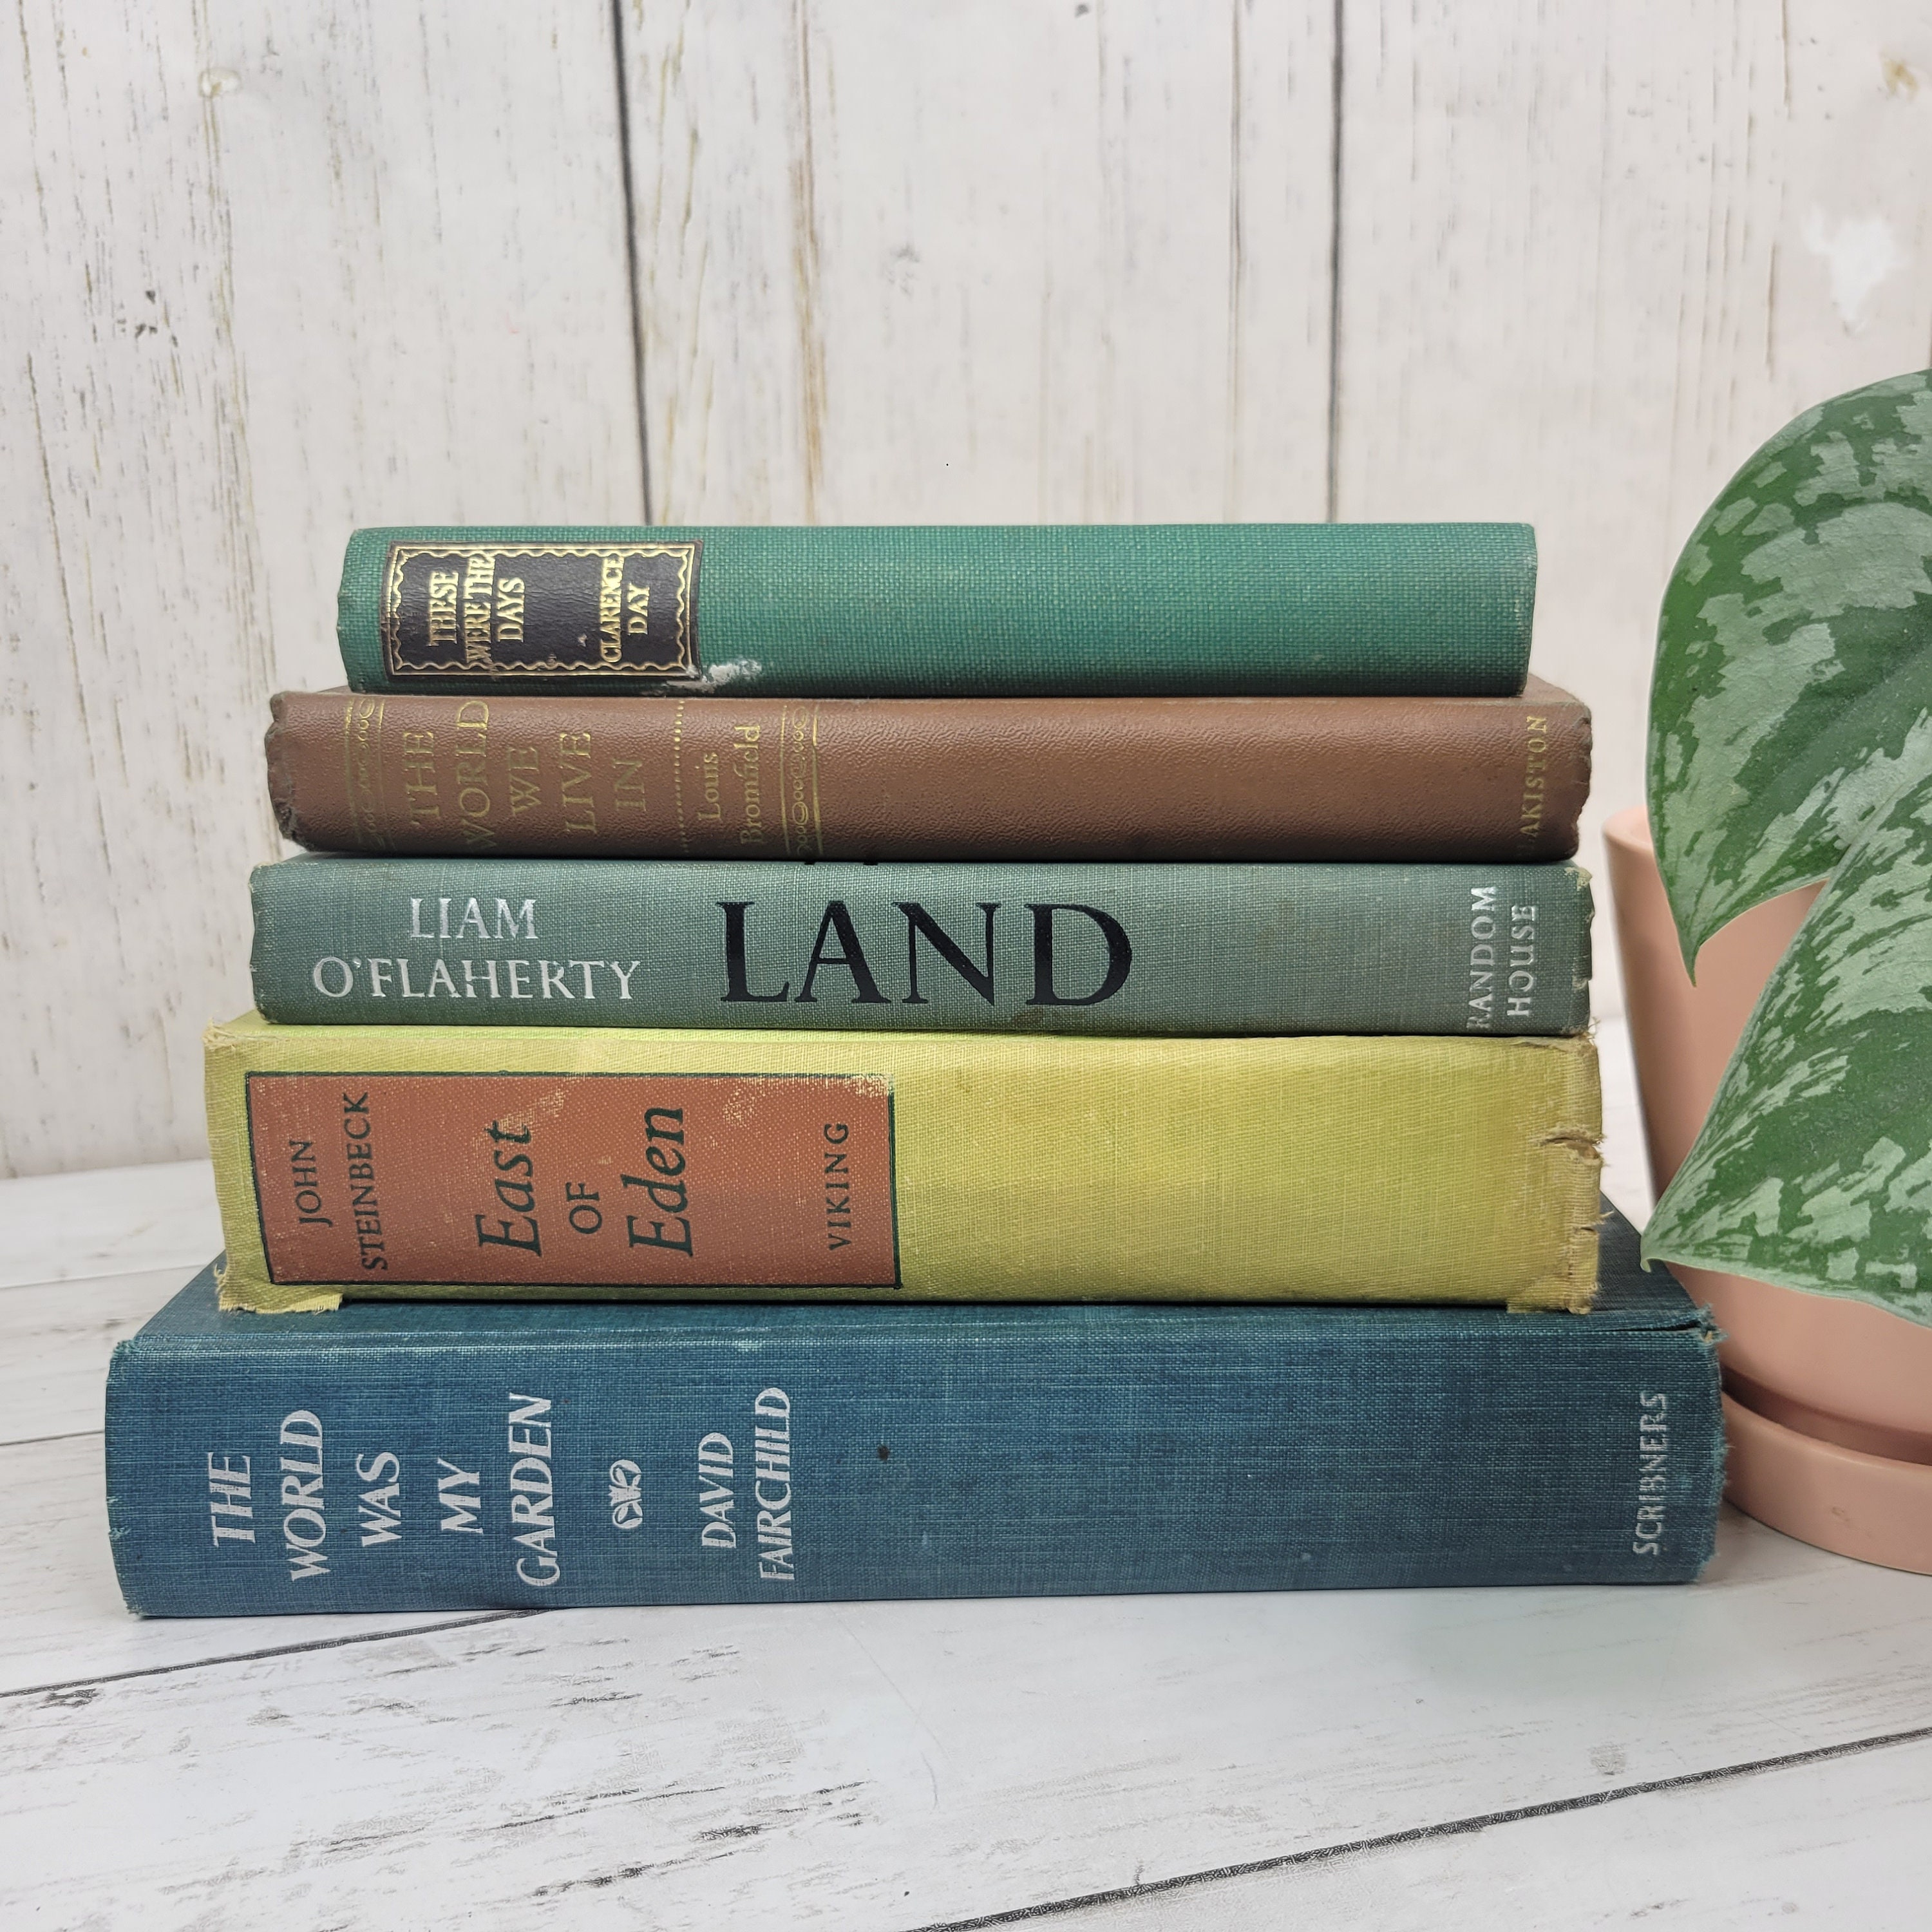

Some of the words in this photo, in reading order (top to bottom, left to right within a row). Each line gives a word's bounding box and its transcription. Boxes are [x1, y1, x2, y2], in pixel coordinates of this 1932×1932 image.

[427, 571, 459, 647] THESE
[463, 556, 496, 600] THE
[497, 577, 526, 643] DAYS
[600, 556, 625, 663] CLARENCE
[627, 582, 650, 636] DAY
[464, 602, 493, 664] WERE
[402, 731, 440, 825] THE
[455, 700, 497, 849] WORLD
[507, 746, 542, 817] WE
[559, 732, 598, 834] LIVE
[612, 757, 647, 813] IN
[695, 752, 721, 822] Louis
[734, 725, 764, 844] Bromfield
[1517, 715, 1547, 856] AKISTON
[410, 898, 539, 939] LIAM
[715, 901, 1133, 1006] LAND
[1466, 886, 1497, 1030] RANDOM
[1506, 904, 1537, 1017] HOUSE
[313, 957, 641, 999] O'FLAHERTY
[288, 1139, 333, 1227] JOHN
[343, 1092, 388, 1271] STEINBECK
[474, 1119, 542, 1257] East
[565, 1181, 603, 1235] OF
[620, 1106, 694, 1257] Eden
[823, 1121, 853, 1251] VIKING
[208, 1452, 256, 1546] THE
[279, 1410, 332, 1581] WORLD
[357, 1452, 402, 1546] WAS
[438, 1457, 484, 1534] MY
[509, 1393, 561, 1587] GARDEN
[698, 1432, 737, 1548] DAVID
[754, 1387, 795, 1581] FAIRCHILD
[1633, 1392, 1668, 1556] SCRIBNERS
